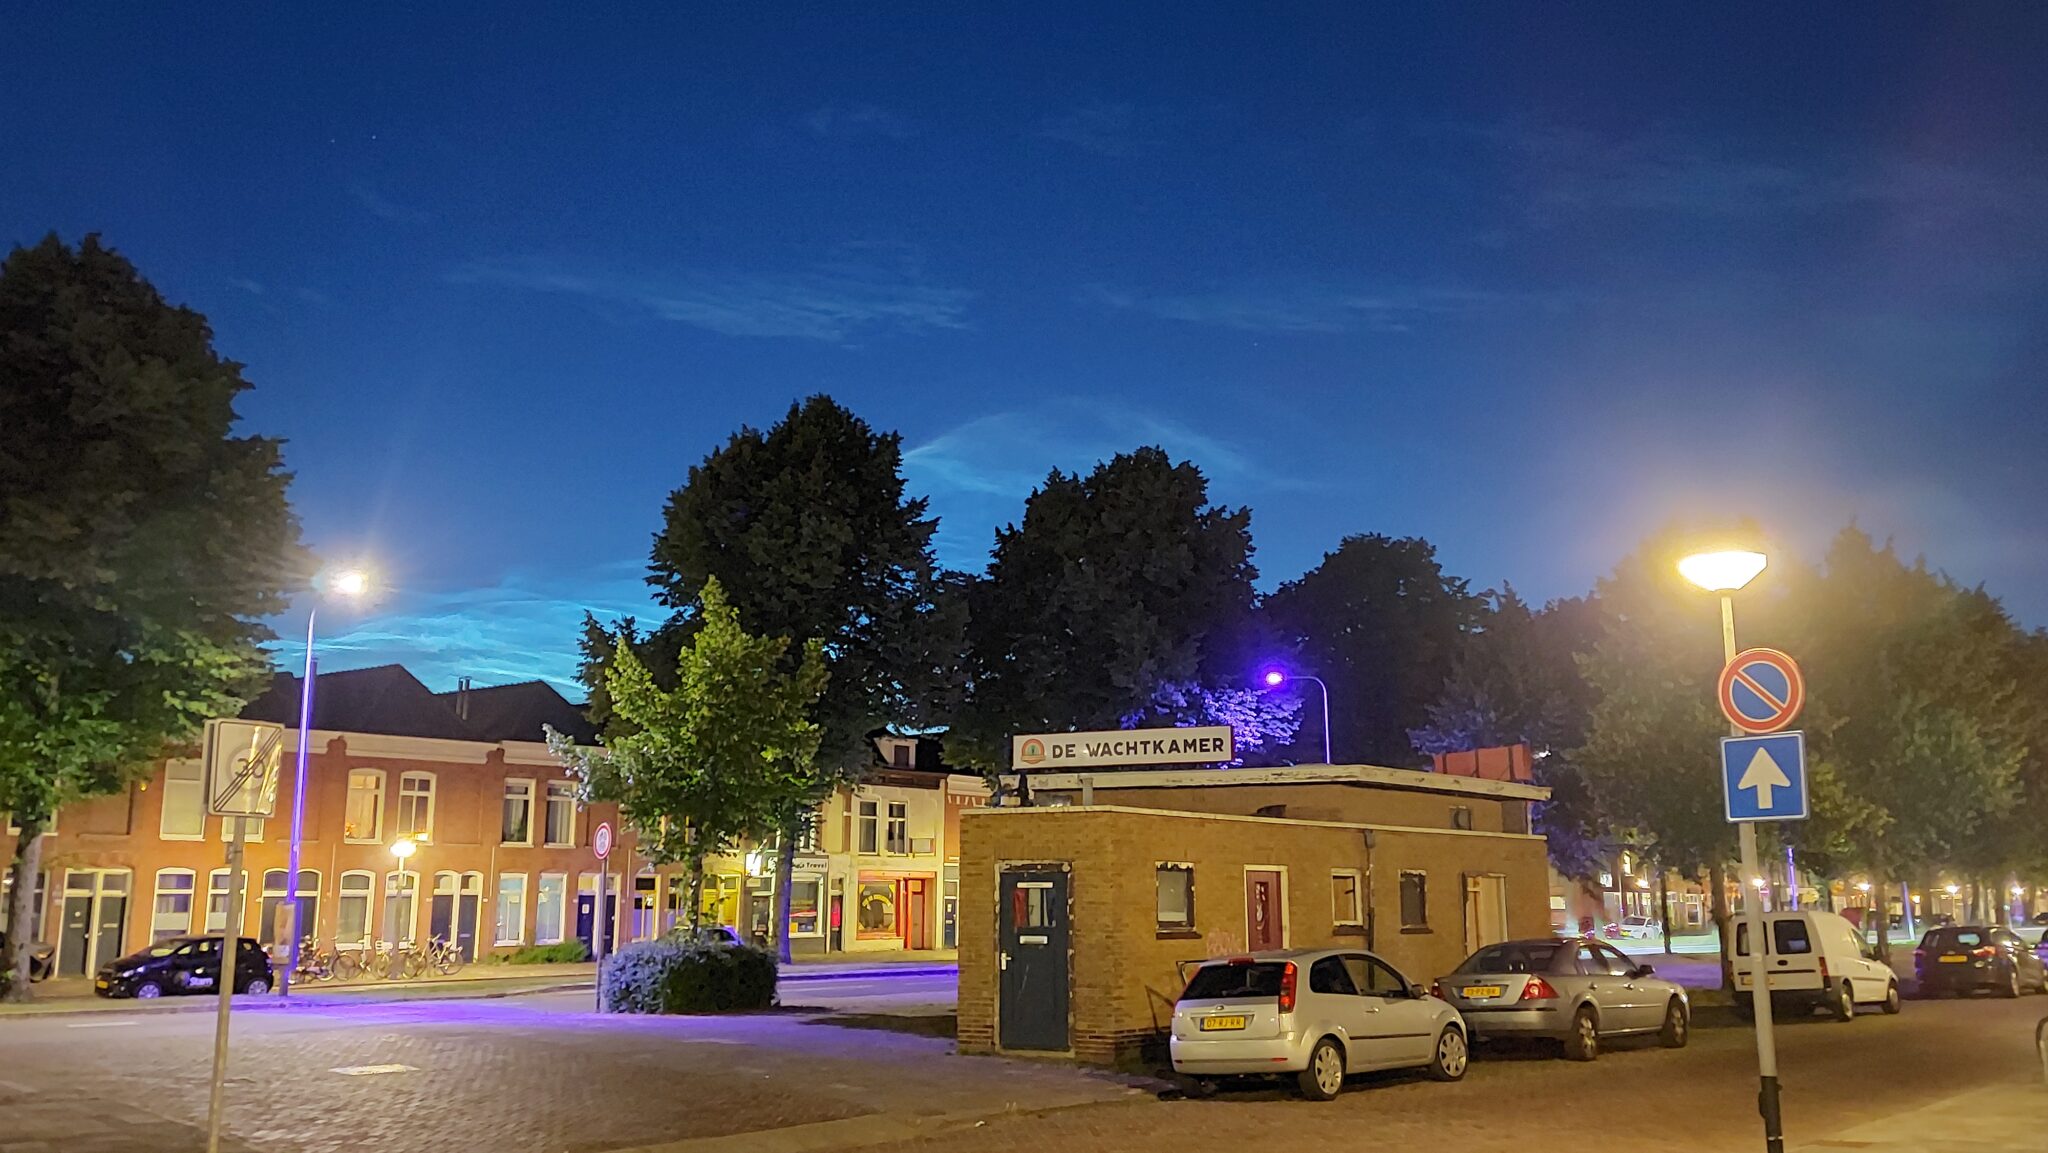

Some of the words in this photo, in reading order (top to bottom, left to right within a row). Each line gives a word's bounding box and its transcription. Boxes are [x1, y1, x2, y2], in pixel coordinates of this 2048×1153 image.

[1052, 744, 1076, 759] DE
[1086, 737, 1225, 758] WACHTKAMER
[234, 757, 266, 779] 30
